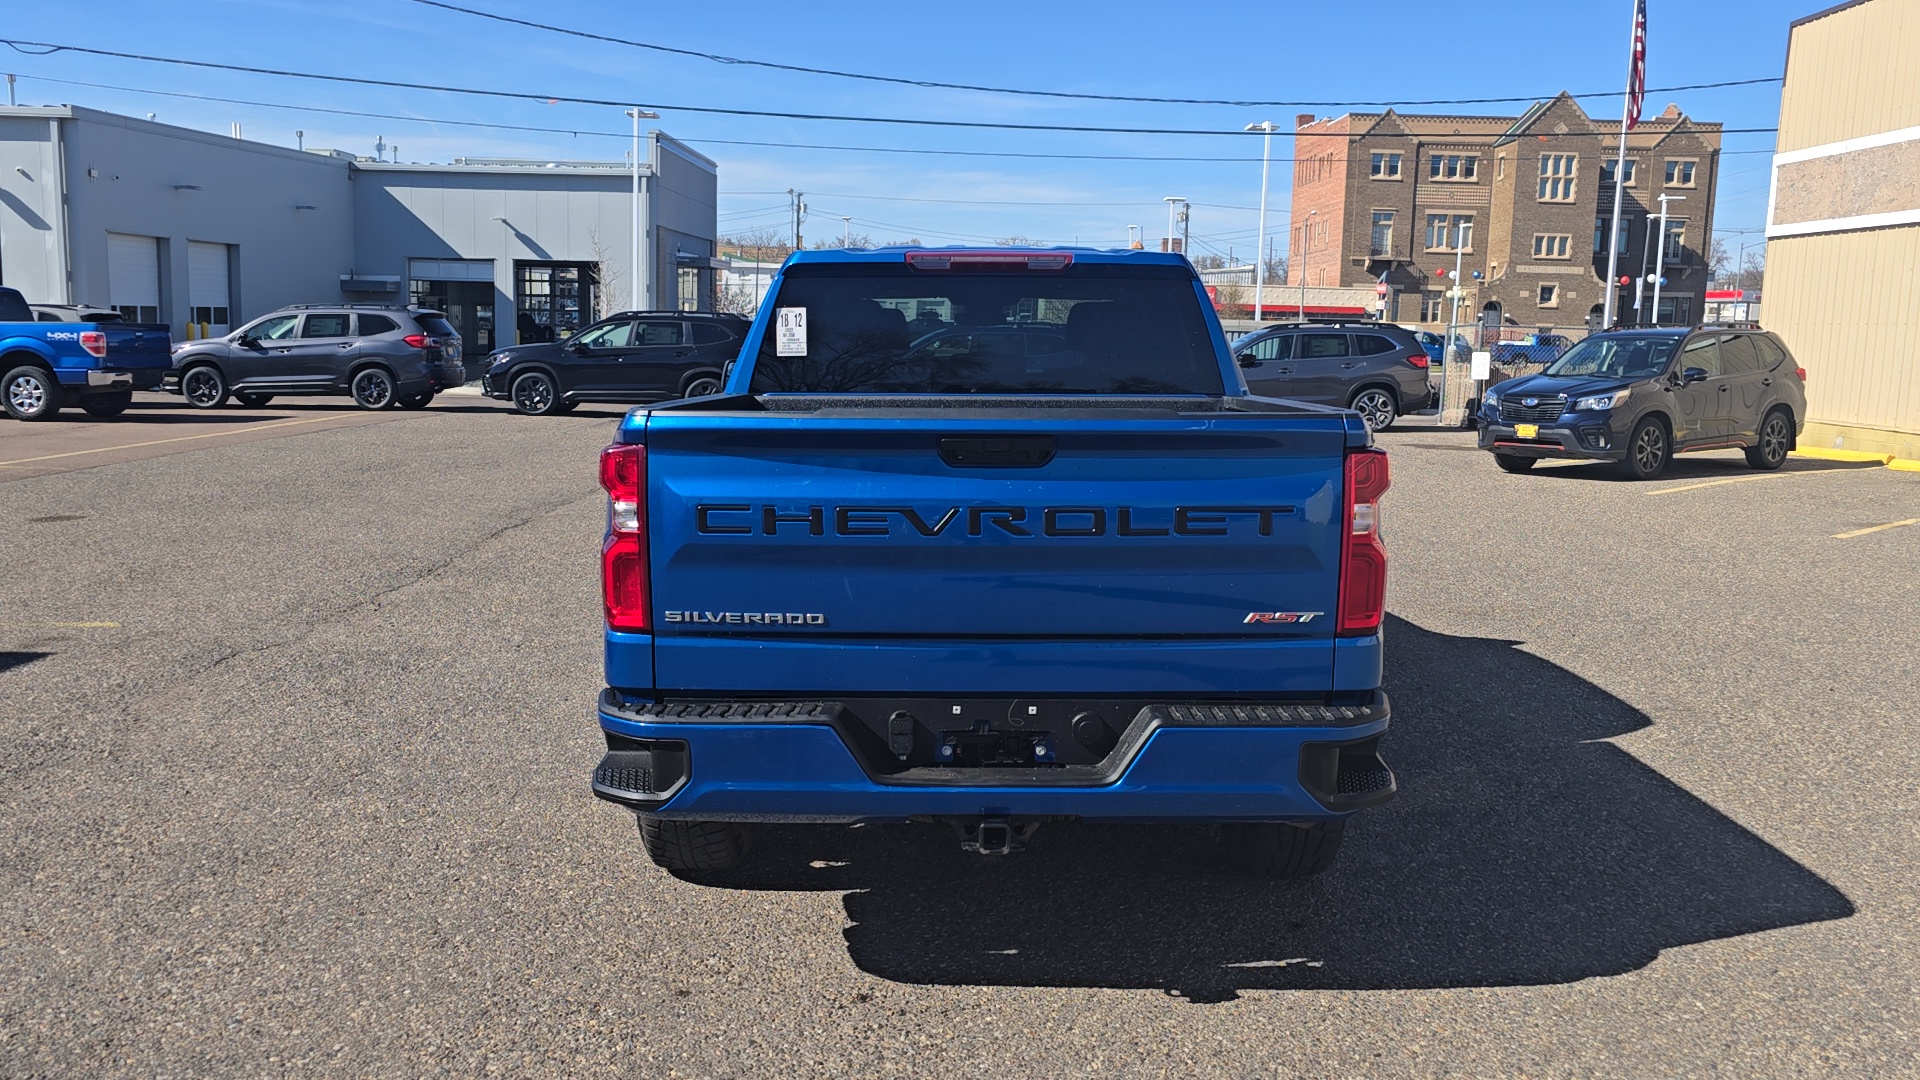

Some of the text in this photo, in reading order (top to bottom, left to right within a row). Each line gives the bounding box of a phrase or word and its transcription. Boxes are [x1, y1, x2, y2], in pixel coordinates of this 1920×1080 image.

[794, 312, 803, 328] 12
[697, 505, 1297, 537] CHEVROLET
[664, 610, 825, 624] SILVERADO
[1243, 611, 1325, 624] RST
